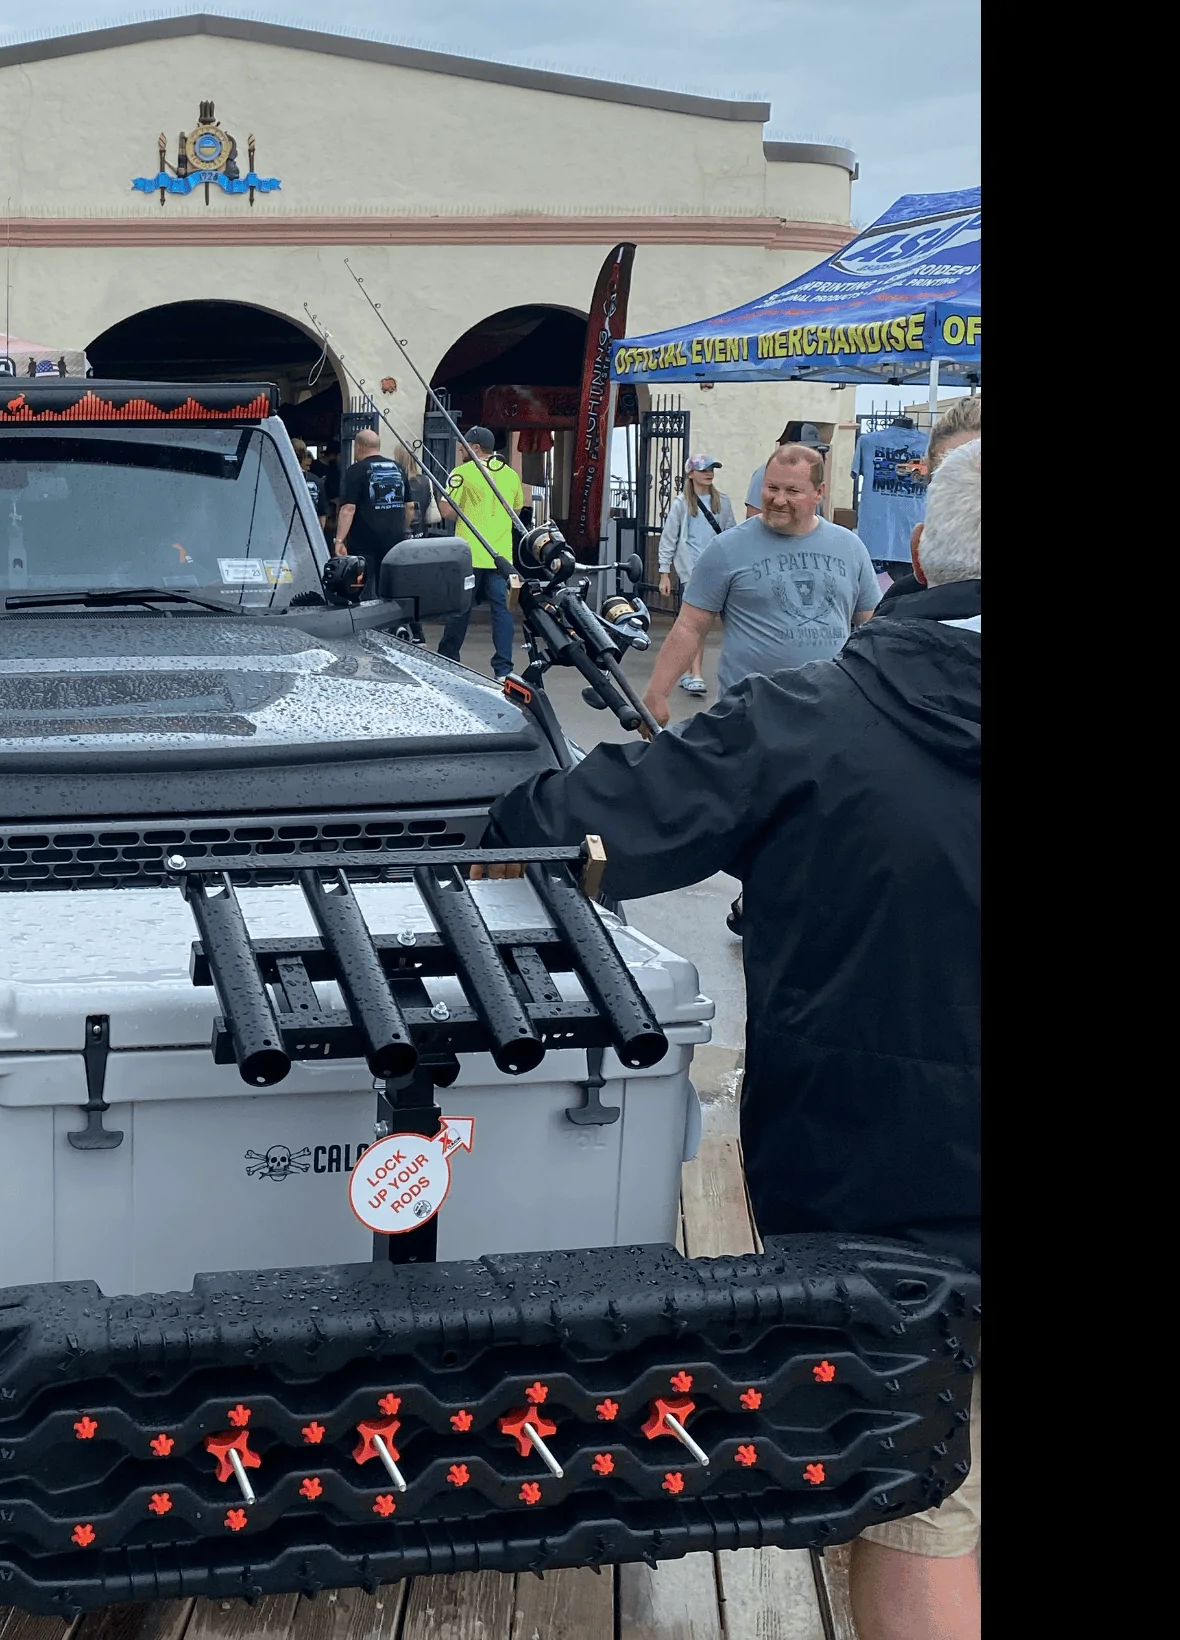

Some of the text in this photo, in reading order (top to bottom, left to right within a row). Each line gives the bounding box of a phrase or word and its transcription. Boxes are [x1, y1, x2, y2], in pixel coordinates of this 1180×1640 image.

[614, 313, 925, 375] OFFICIAL EVENT MERCHANDISE
[580, 466, 595, 534] LIGHTNING
[252, 569, 260, 577] 23
[366, 1149, 407, 1188] LOCK
[368, 1188, 389, 1209] UP
[388, 1154, 429, 1193] YOUR
[390, 1176, 431, 1213] RODS
